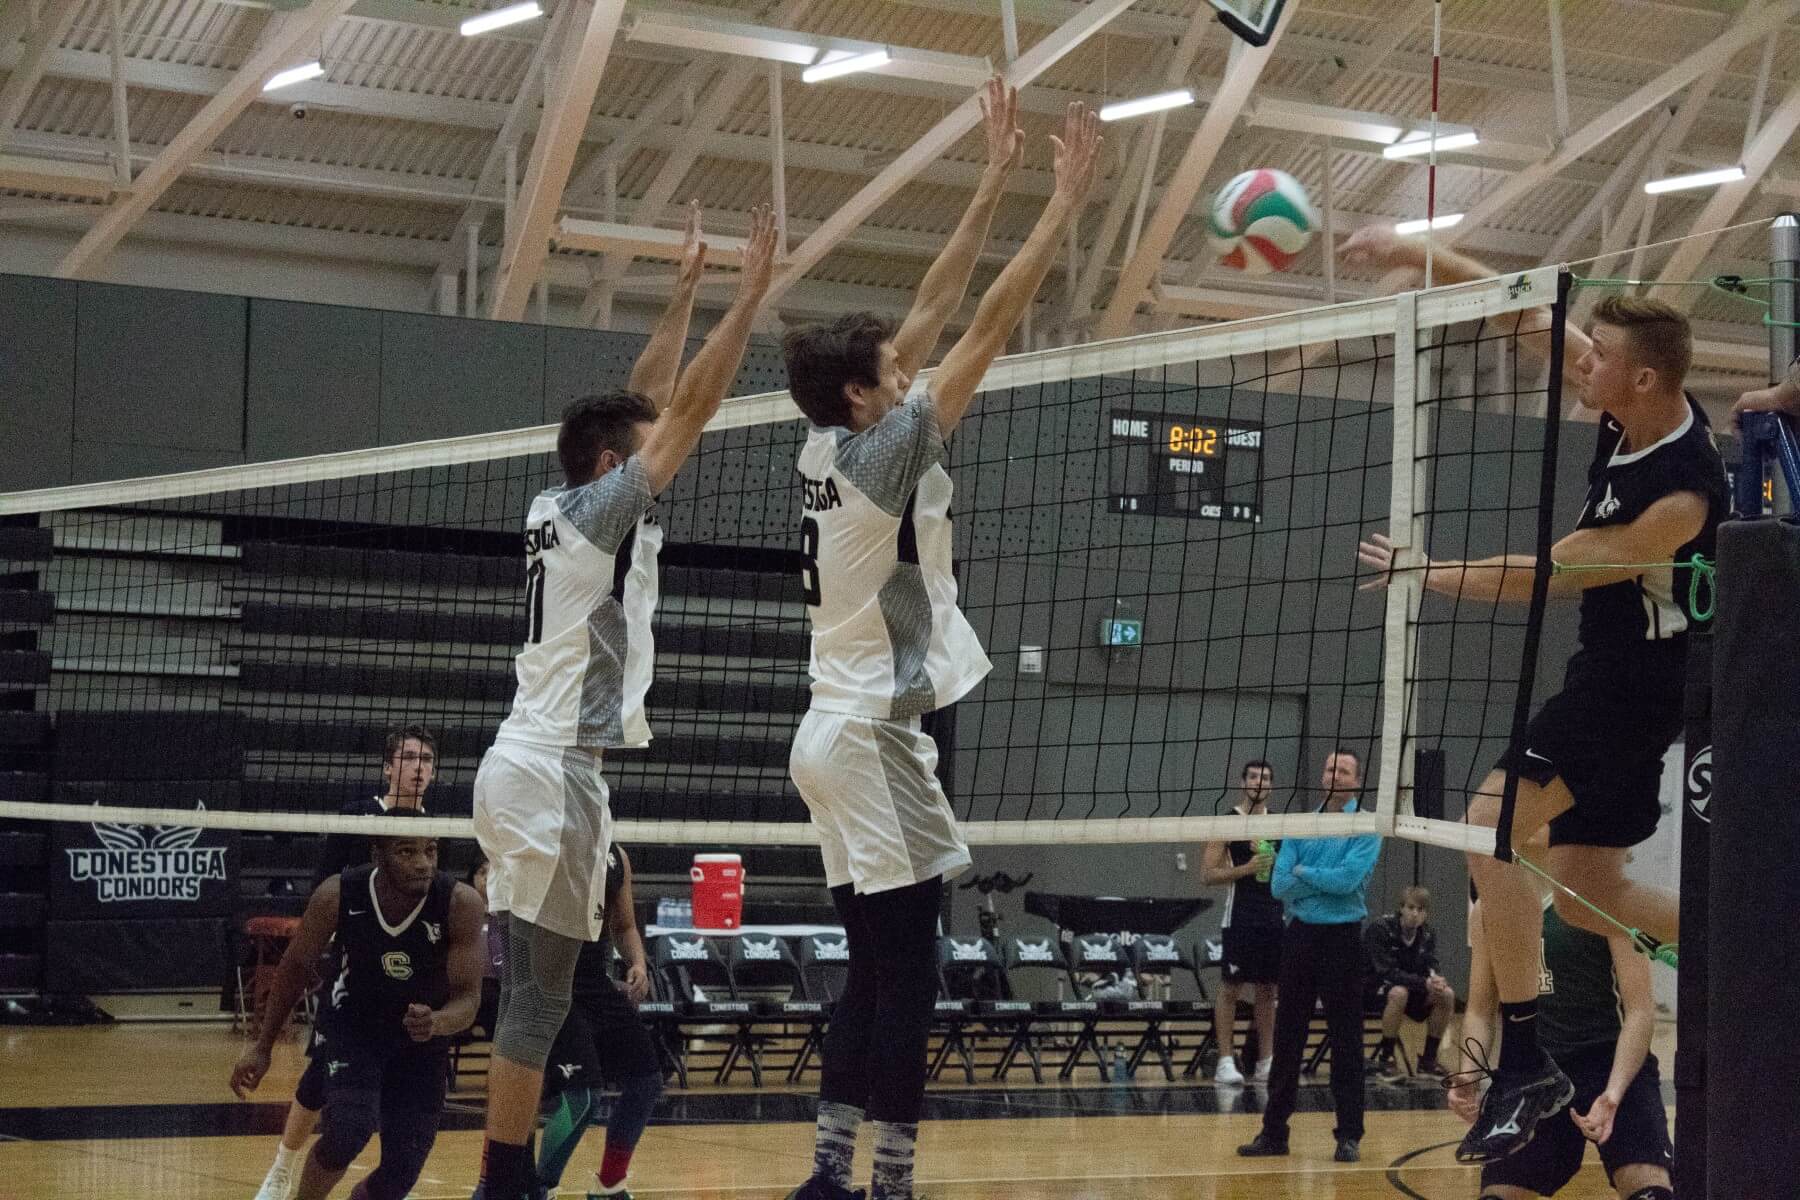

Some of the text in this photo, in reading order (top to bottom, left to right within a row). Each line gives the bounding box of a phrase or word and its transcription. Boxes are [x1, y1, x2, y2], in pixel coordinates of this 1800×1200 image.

[1112, 418, 1149, 438] HOME
[1169, 425, 1218, 454] 8:02
[1224, 427, 1261, 448] GUEST
[1169, 457, 1204, 474] PERIOD
[68, 849, 227, 880] CONESTOGA
[98, 876, 201, 902] CONDORS
